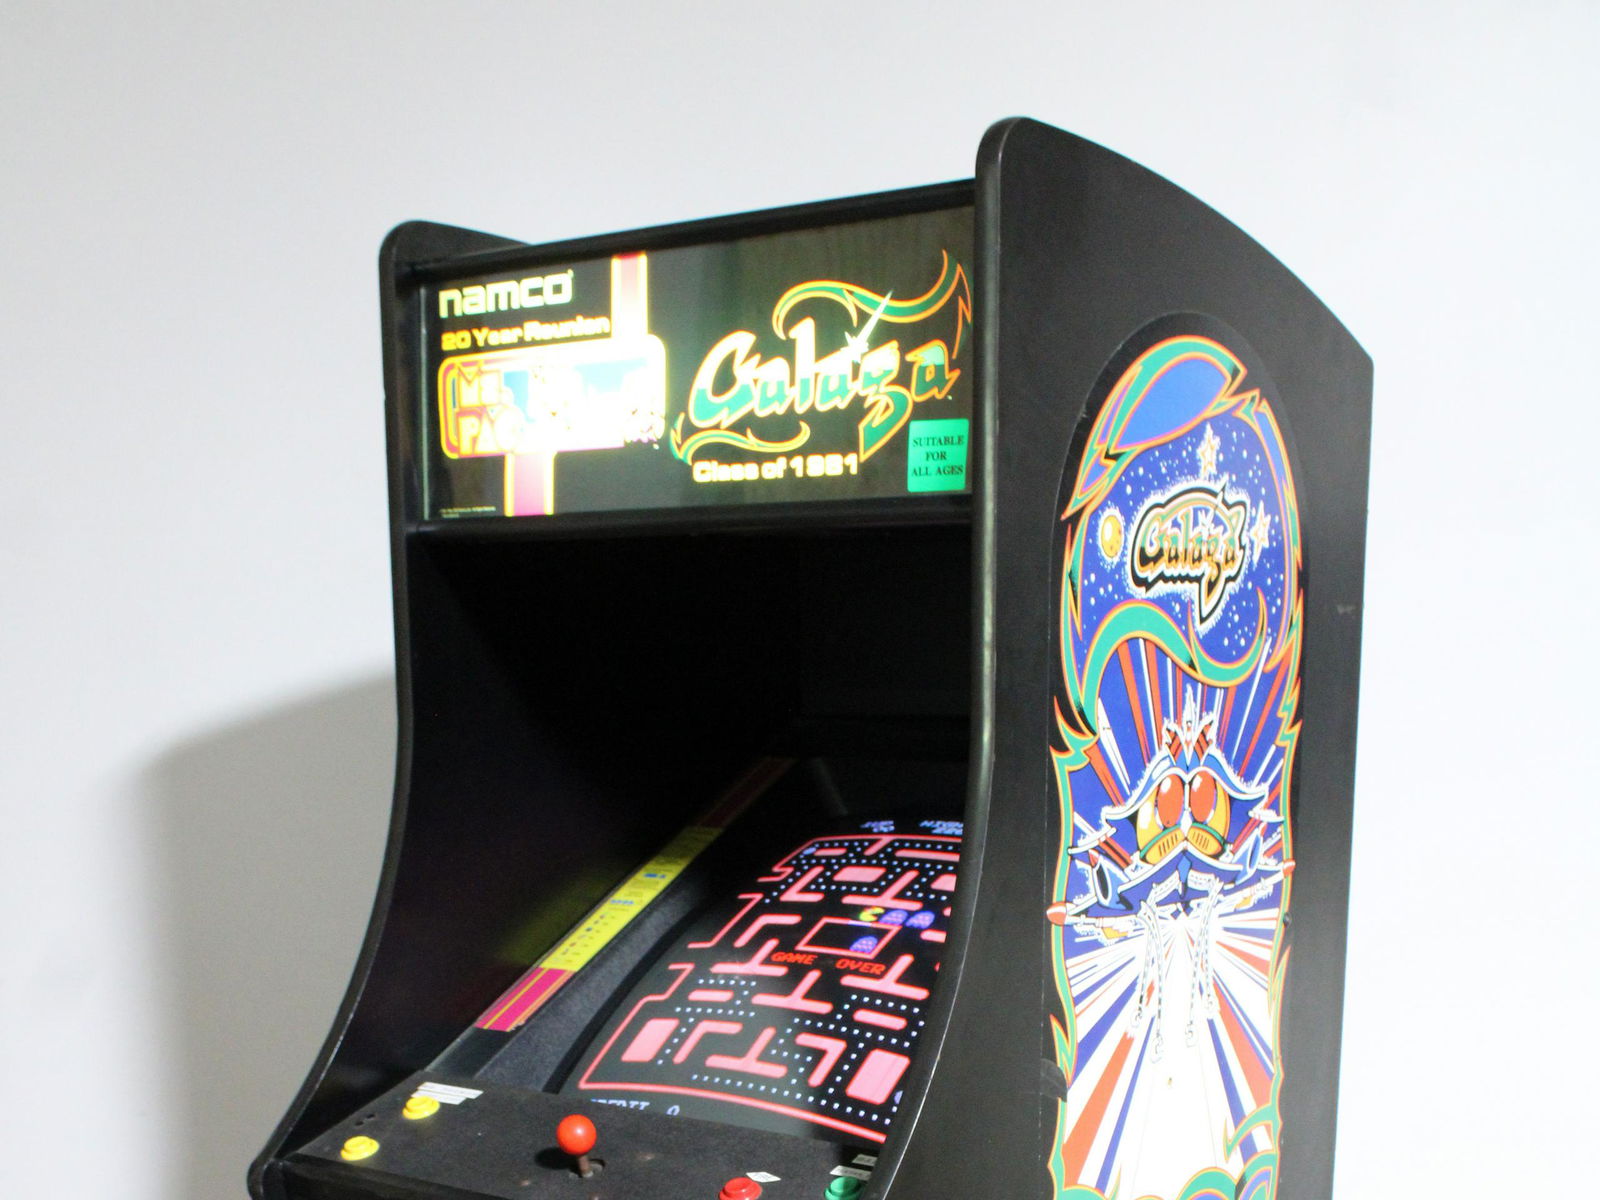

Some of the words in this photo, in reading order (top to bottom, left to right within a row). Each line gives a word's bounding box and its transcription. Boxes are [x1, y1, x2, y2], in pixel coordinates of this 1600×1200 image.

[439, 270, 573, 318] namco
[441, 331, 471, 351] 20
[472, 327, 523, 347] Year
[523, 315, 611, 341] Reunion
[688, 316, 963, 463] Galaga
[912, 435, 965, 447] SUITABLE
[925, 450, 947, 461] FOR
[693, 459, 759, 483] Class
[761, 456, 787, 479] of
[911, 466, 932, 477] ALL
[935, 464, 964, 476] AGES
[771, 951, 818, 965] GAME
[836, 958, 886, 975] OVER
